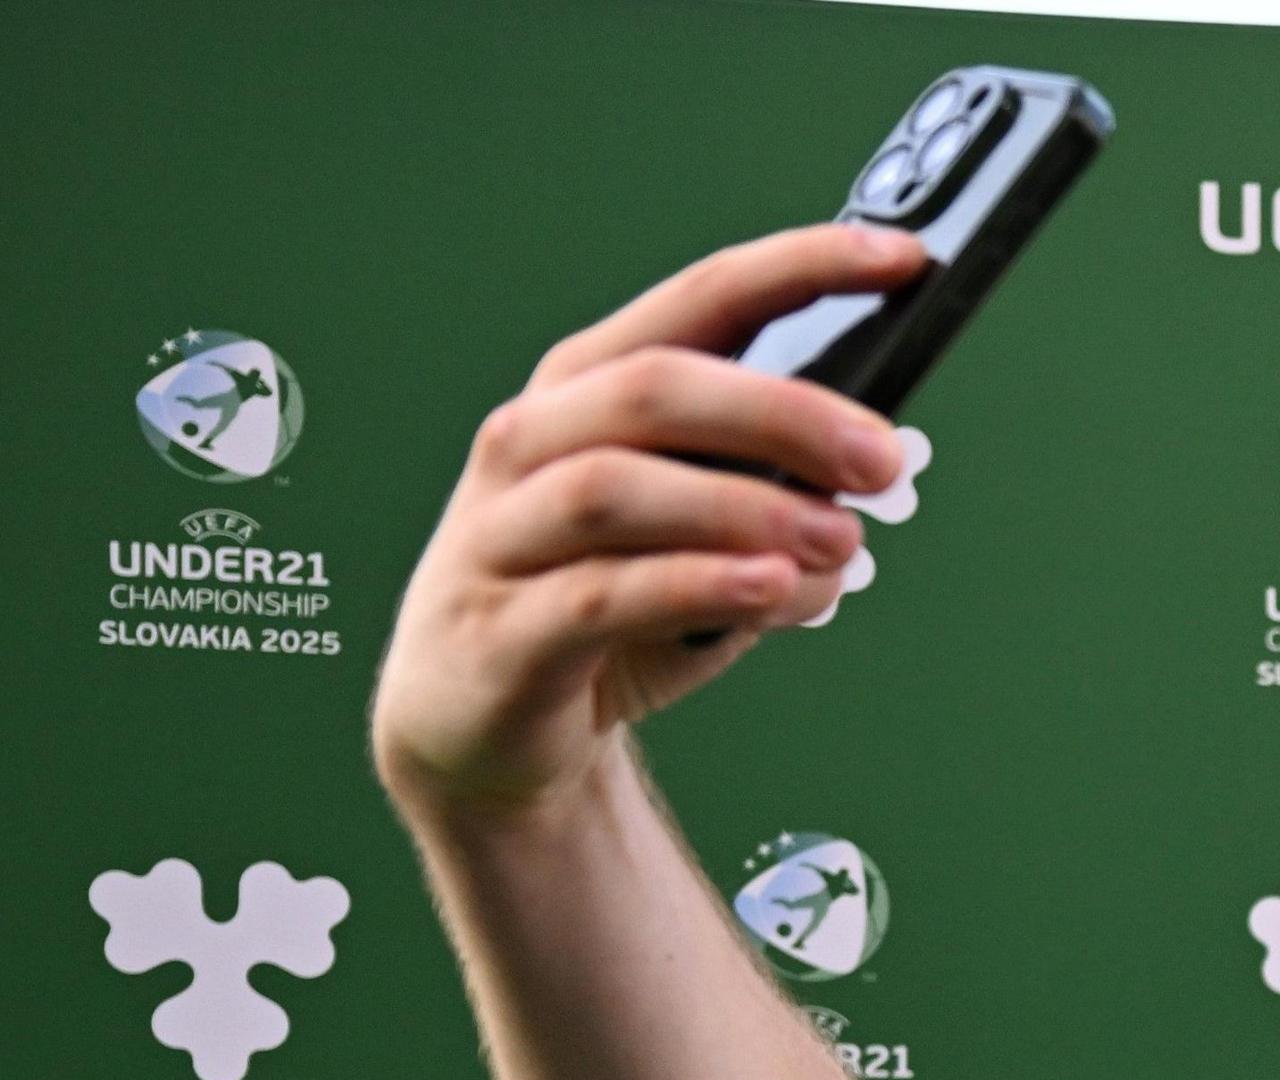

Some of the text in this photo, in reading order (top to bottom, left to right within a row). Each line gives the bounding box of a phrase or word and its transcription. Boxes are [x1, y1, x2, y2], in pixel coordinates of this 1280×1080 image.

[180, 509, 261, 545] UEFA
[109, 540, 329, 586] UNDER21
[110, 584, 329, 616] CHAMPIONSHIP
[99, 620, 341, 655] SLOVAKIA 2025
